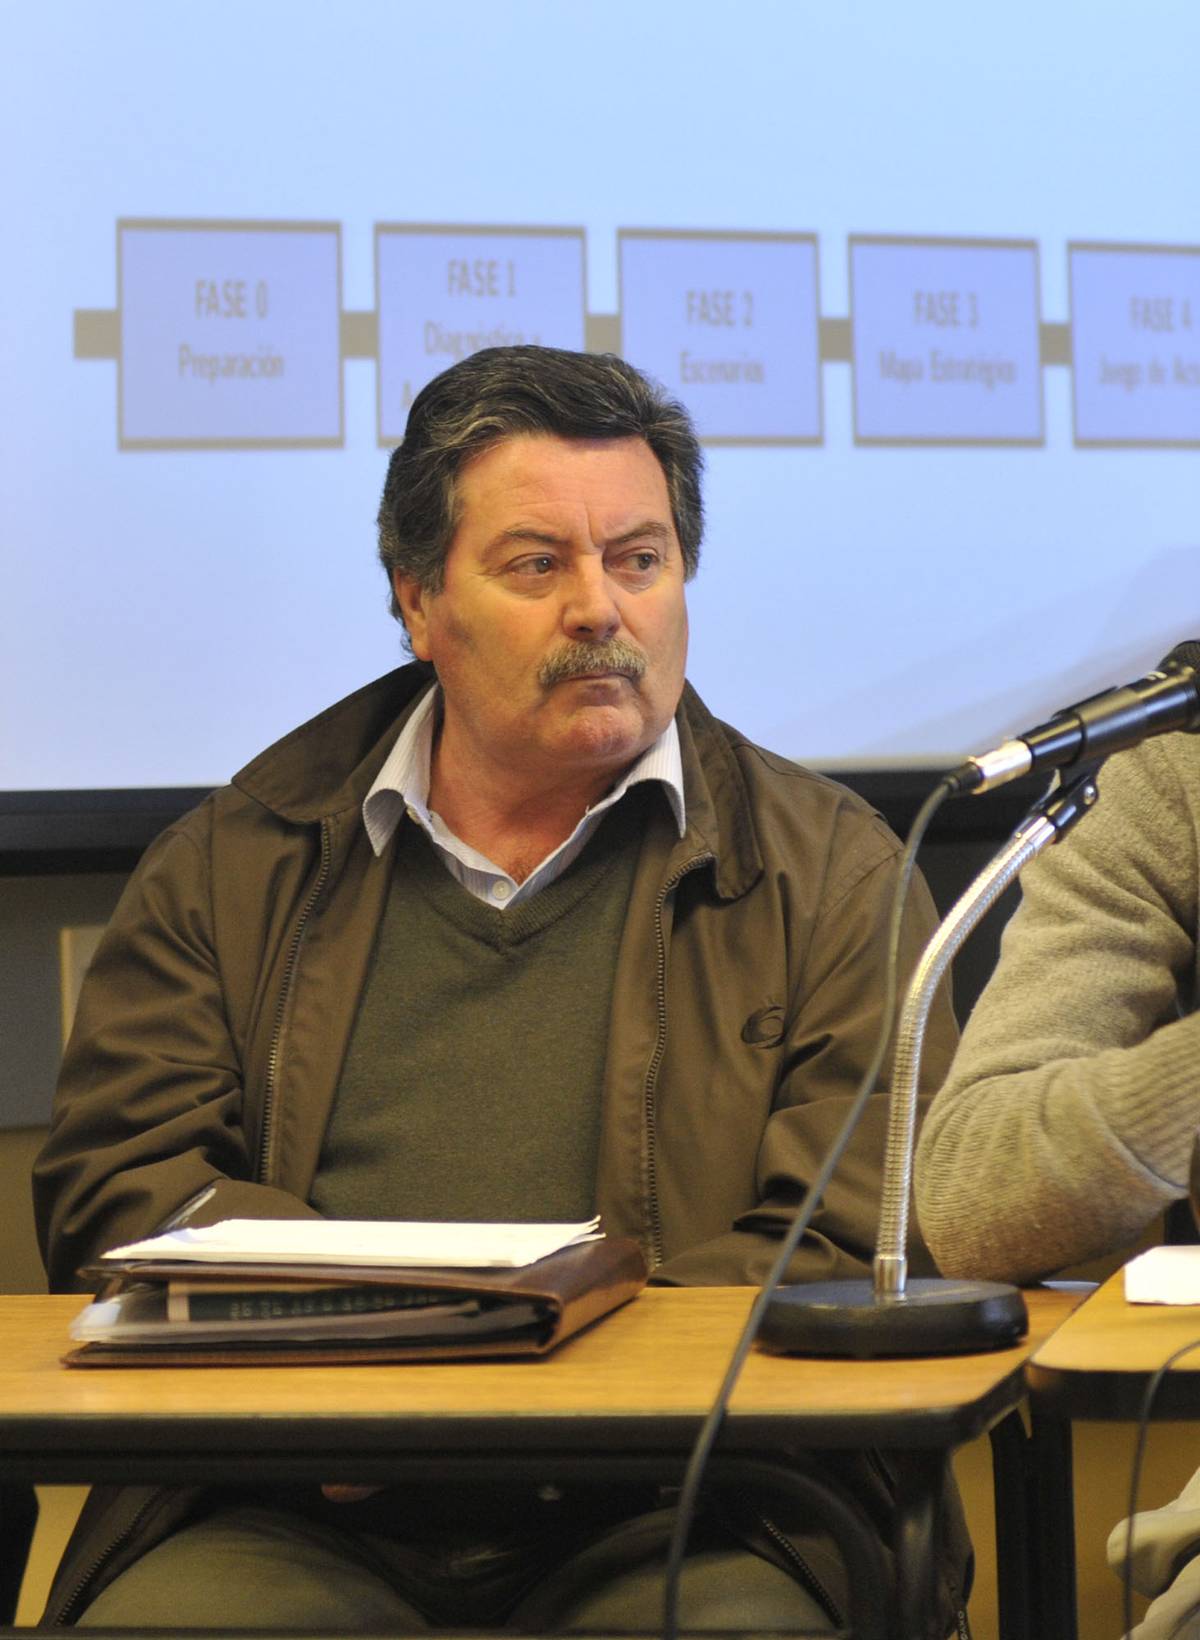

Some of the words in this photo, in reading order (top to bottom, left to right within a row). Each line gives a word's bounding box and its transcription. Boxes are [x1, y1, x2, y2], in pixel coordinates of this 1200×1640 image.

[447, 260, 500, 297] FASE
[506, 260, 517, 298] 1
[194, 279, 246, 319] FASE
[255, 279, 269, 319] 0
[686, 289, 737, 327] FASE
[741, 289, 754, 328] 2
[913, 290, 961, 327] FASE
[1128, 296, 1174, 333] FASE
[178, 342, 285, 384] Preparación
